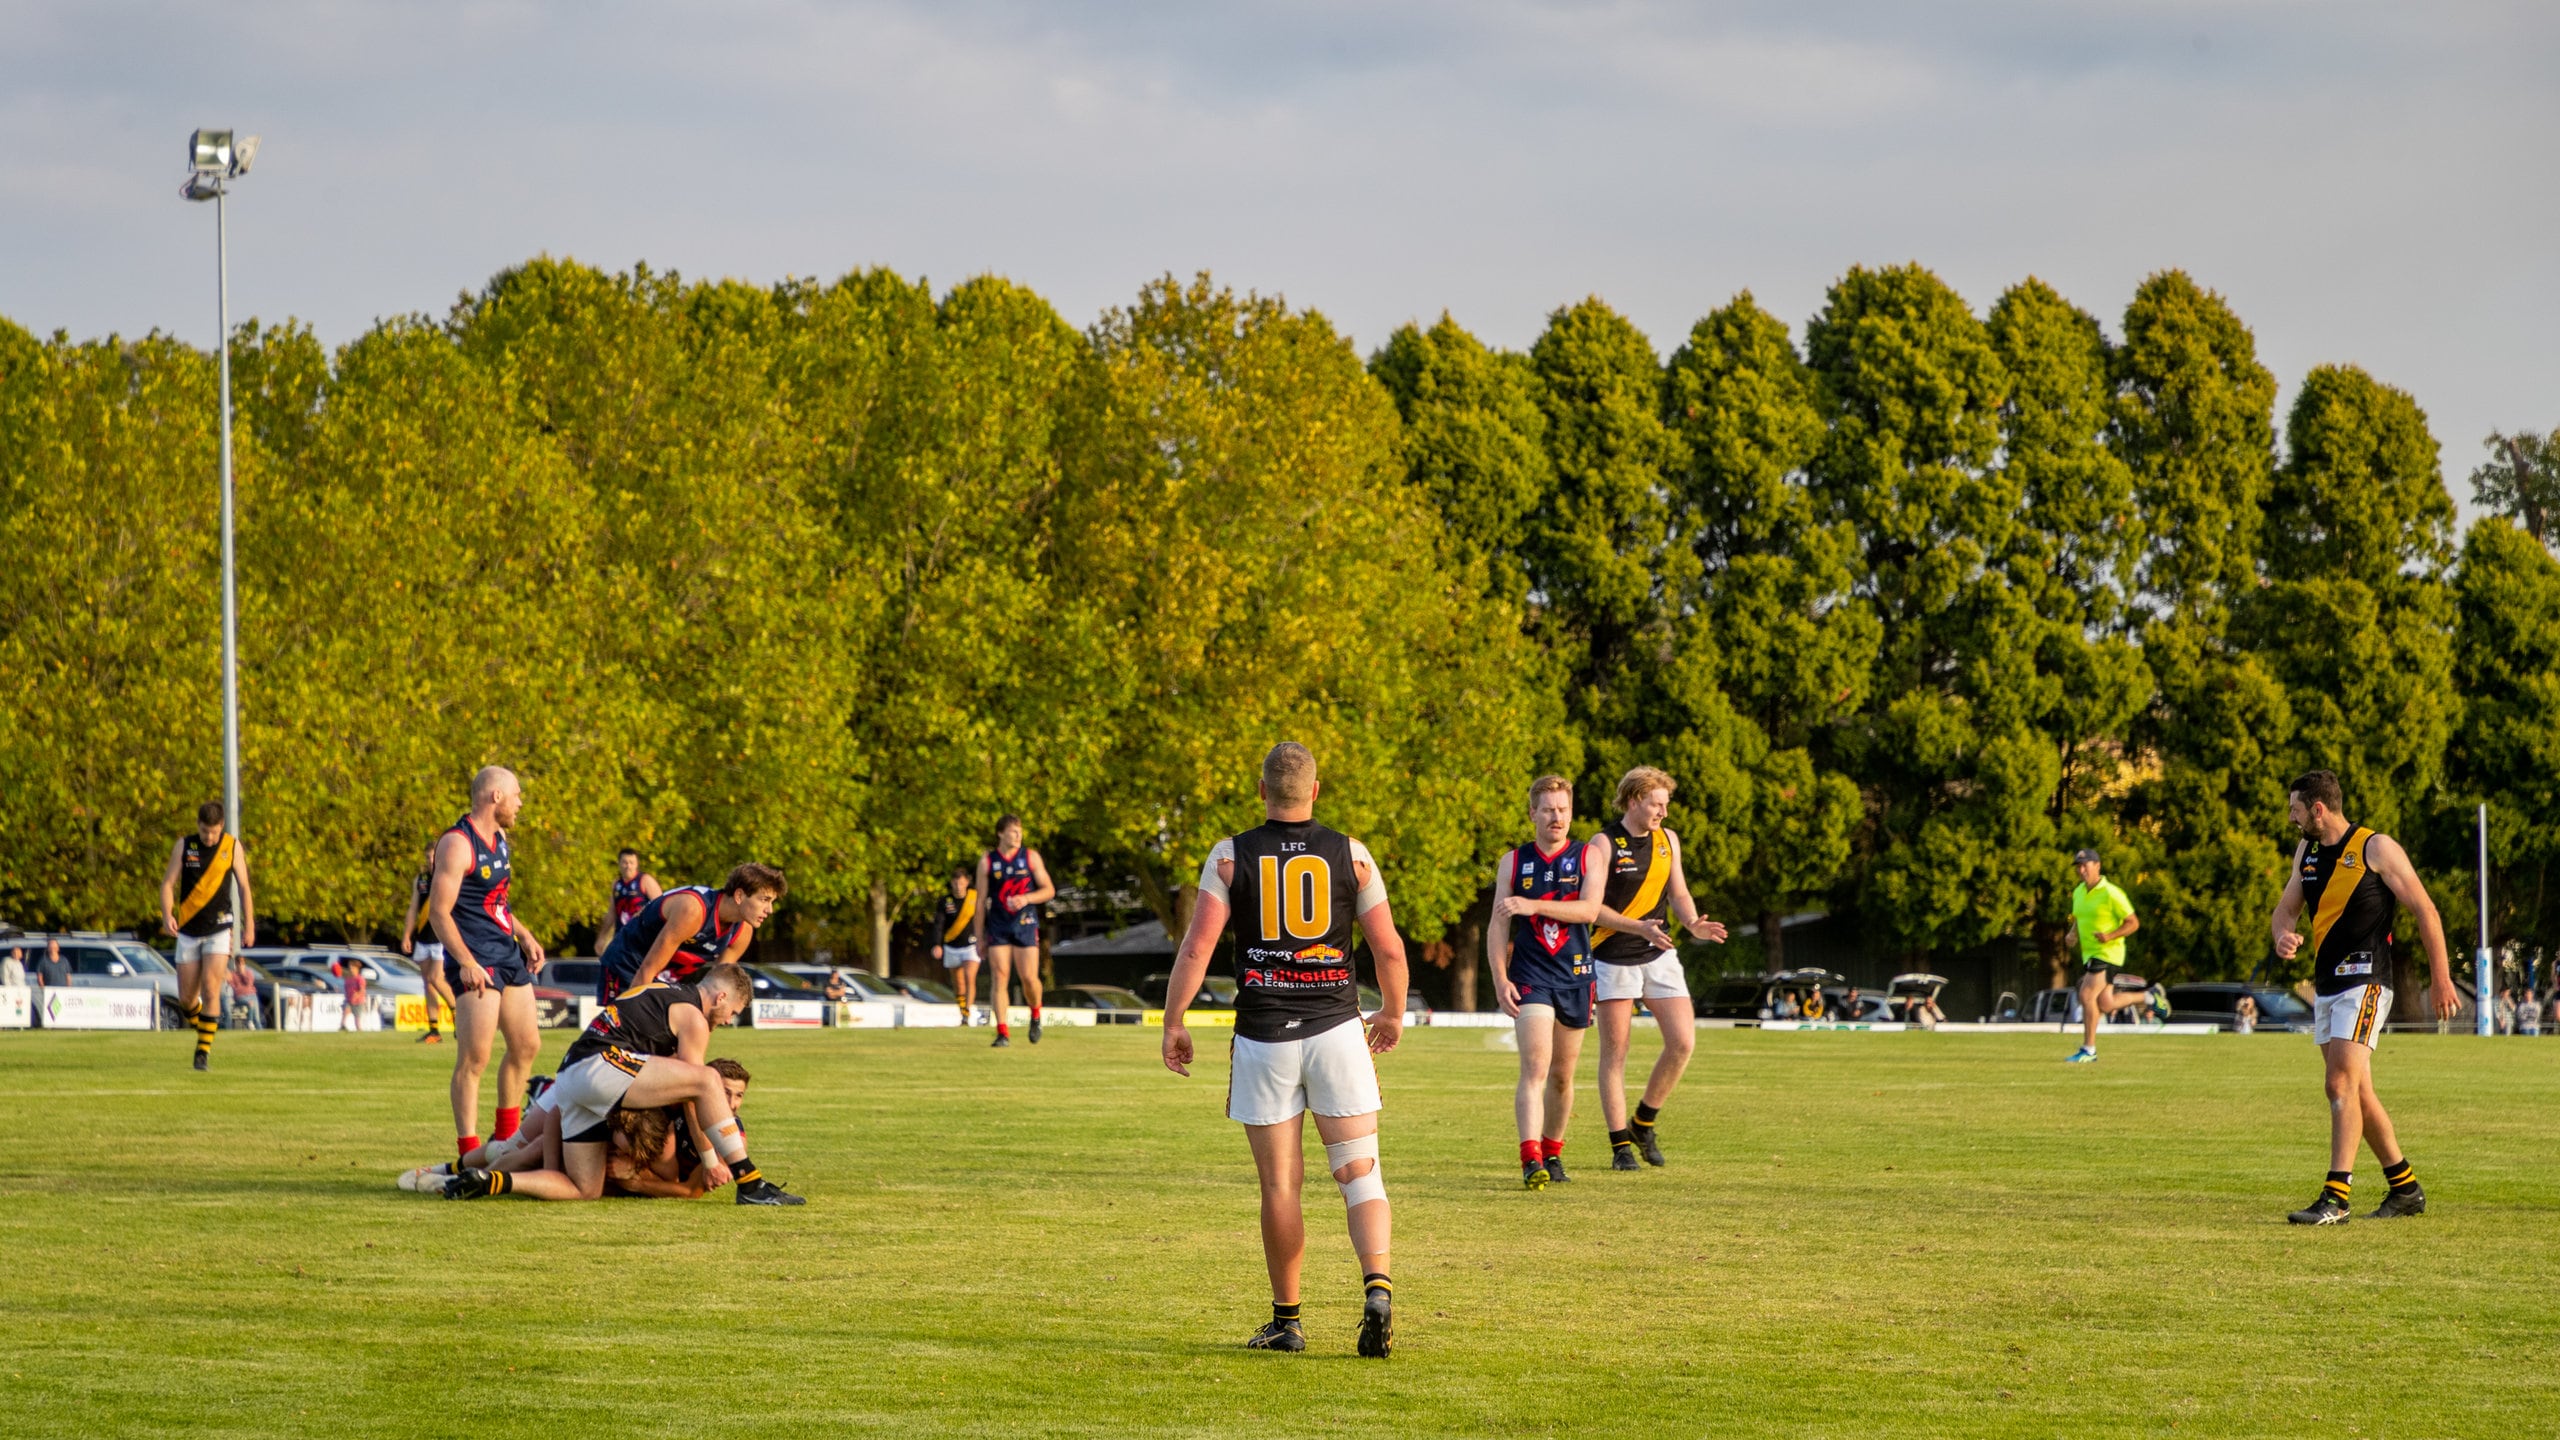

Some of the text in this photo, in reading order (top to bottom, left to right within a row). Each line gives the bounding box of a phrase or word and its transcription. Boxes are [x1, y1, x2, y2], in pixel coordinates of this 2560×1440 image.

[1281, 842, 1306, 851] LFC
[1259, 854, 1331, 941] 10
[1272, 969, 1350, 982] HUGHES
[1272, 981, 1336, 989] CONSTRUCTION
